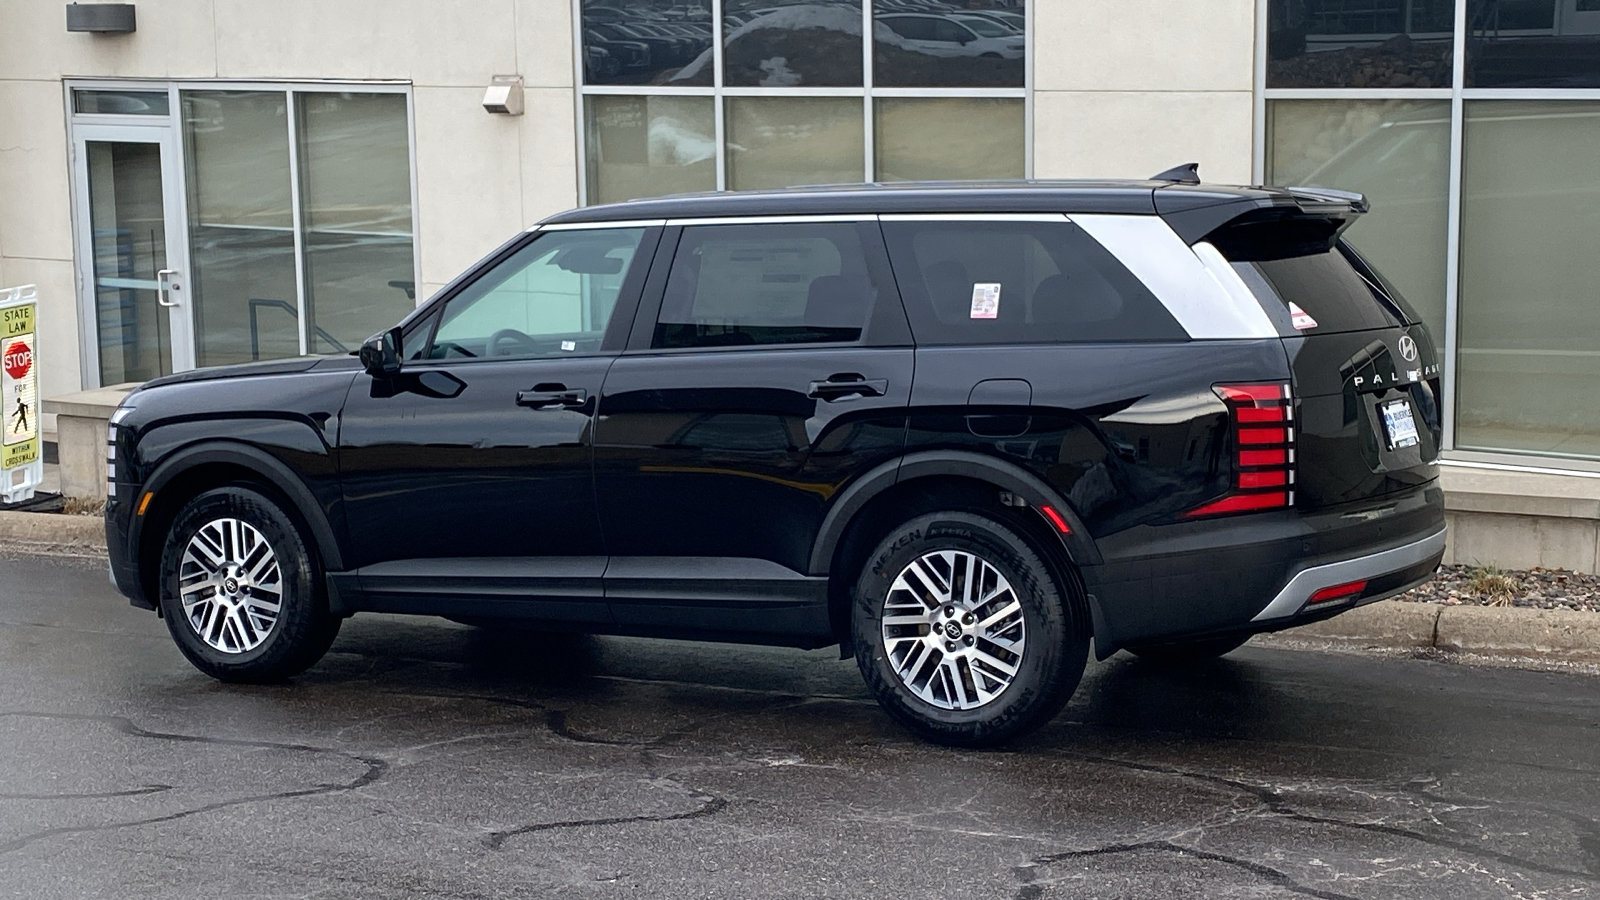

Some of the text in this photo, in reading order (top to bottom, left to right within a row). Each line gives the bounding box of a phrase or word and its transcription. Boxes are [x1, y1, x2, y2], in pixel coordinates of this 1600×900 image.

[5, 308, 29, 321] STATE
[9, 322, 26, 333] LAW
[5, 352, 32, 369] STOP
[15, 384, 27, 393] FOR
[12, 444, 30, 454] WITHIN
[5, 452, 35, 466] CROSSWALK
[872, 529, 922, 576] NEXEN
